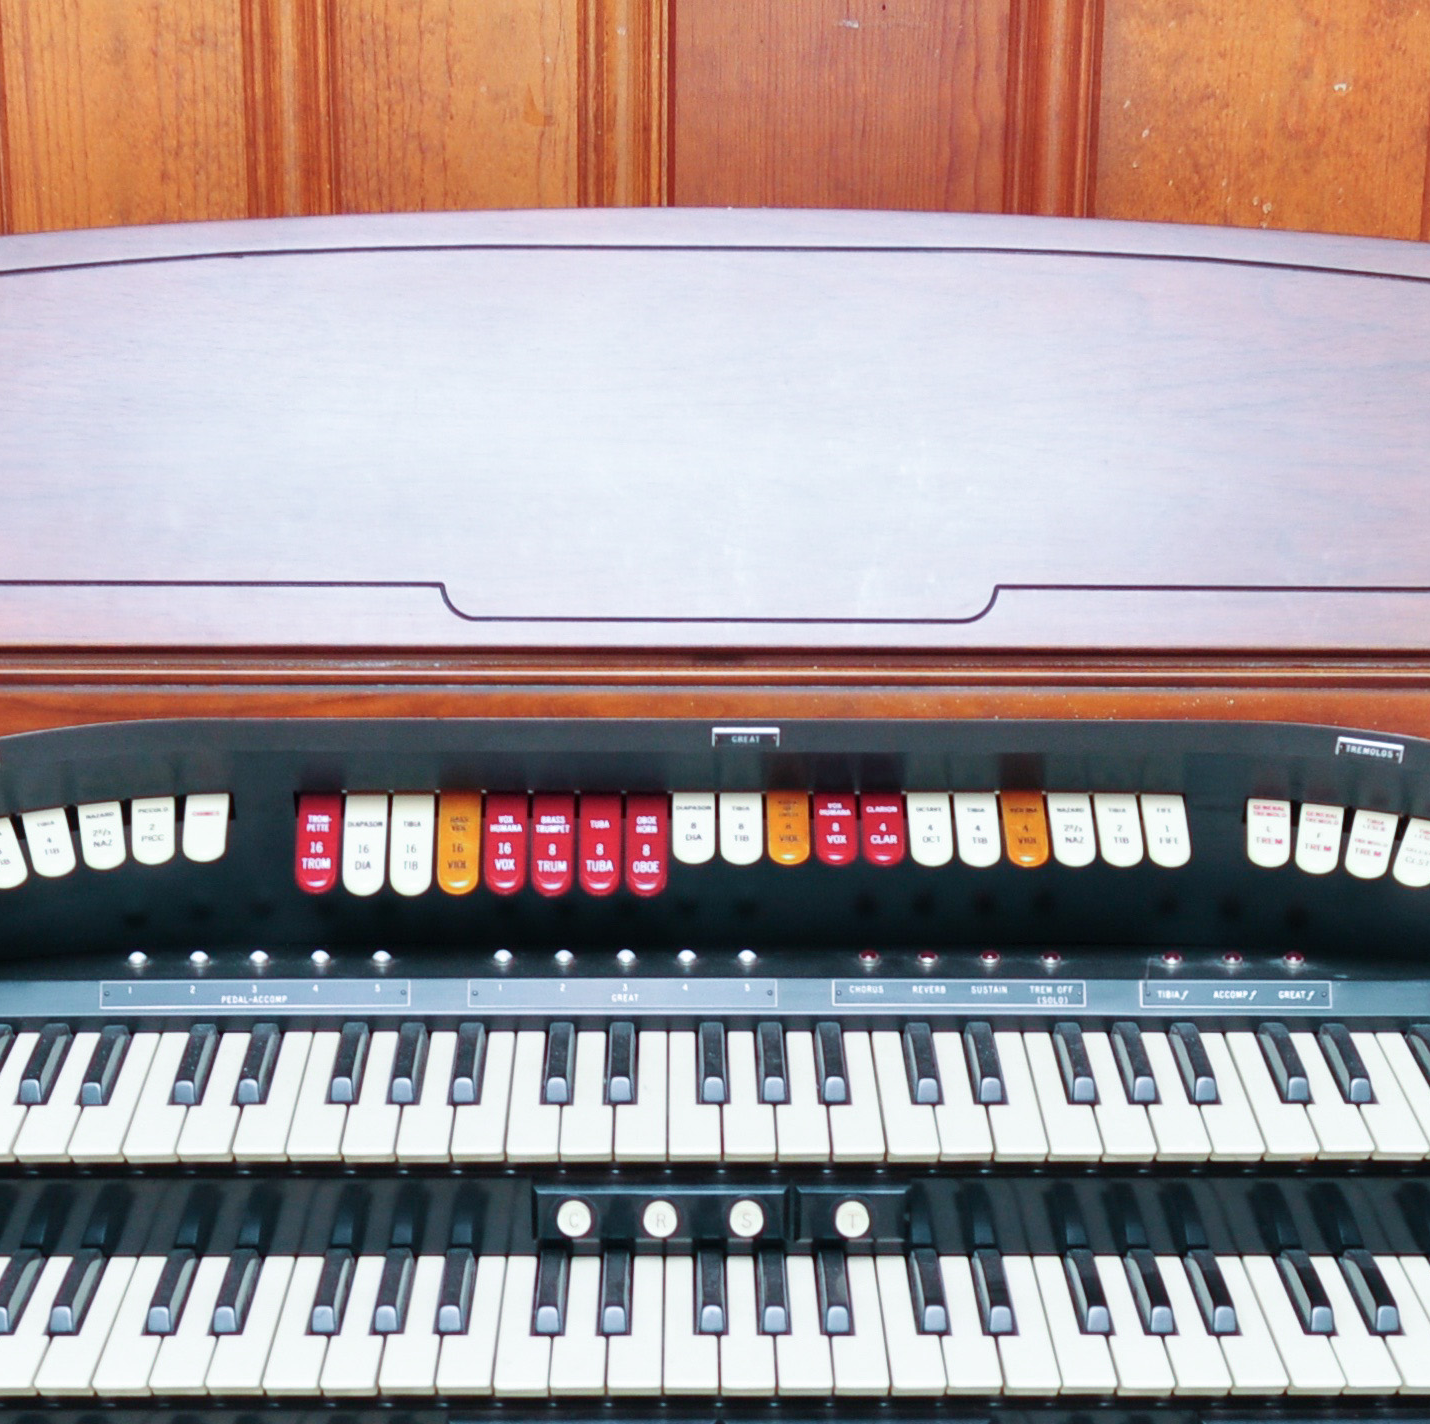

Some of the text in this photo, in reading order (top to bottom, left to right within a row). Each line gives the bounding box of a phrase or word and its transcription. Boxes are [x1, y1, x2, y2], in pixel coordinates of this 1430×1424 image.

[731, 736, 760, 744] GREAT
[1346, 745, 1393, 758] TREMOLOS
[541, 816, 566, 824] BRASS
[590, 820, 610, 829] TUBA
[636, 816, 657, 824] OBOE
[306, 823, 330, 832] PETTE
[490, 824, 522, 832] HUMANA
[535, 825, 570, 833] TRUMPET
[636, 825, 658, 834] HORN
[141, 834, 164, 842] PICC
[826, 835, 847, 844] VOX
[870, 835, 898, 844] CLAR
[1256, 837, 1283, 845] TREM
[93, 839, 113, 847] NAZ
[310, 842, 323, 853] 16
[1305, 843, 1332, 851] TREM
[44, 847, 60, 855] TIB
[358, 844, 369, 853] 16
[406, 844, 417, 853] 16
[452, 844, 463, 853] 16
[498, 842, 511, 854] 16
[548, 843, 556, 856] 8
[596, 843, 604, 856] 8
[642, 844, 650, 856] 8
[1355, 848, 1382, 857] TREM
[302, 858, 331, 869] TROM
[355, 862, 371, 870] DIA
[403, 861, 418, 870] TIB
[495, 859, 515, 870] VOX
[537, 860, 567, 872] TRUM
[586, 860, 613, 872] TUBA
[633, 861, 660, 873] OBOE
[849, 985, 1073, 994] CHORUS REVERB SUSTAIN TREM OFF
[221, 995, 288, 1004] PEDAL-ACCOMP
[611, 994, 639, 1002] GREAT
[1037, 997, 1068, 1005] (SOLO)
[568, 1213, 858, 1228] C R S T
